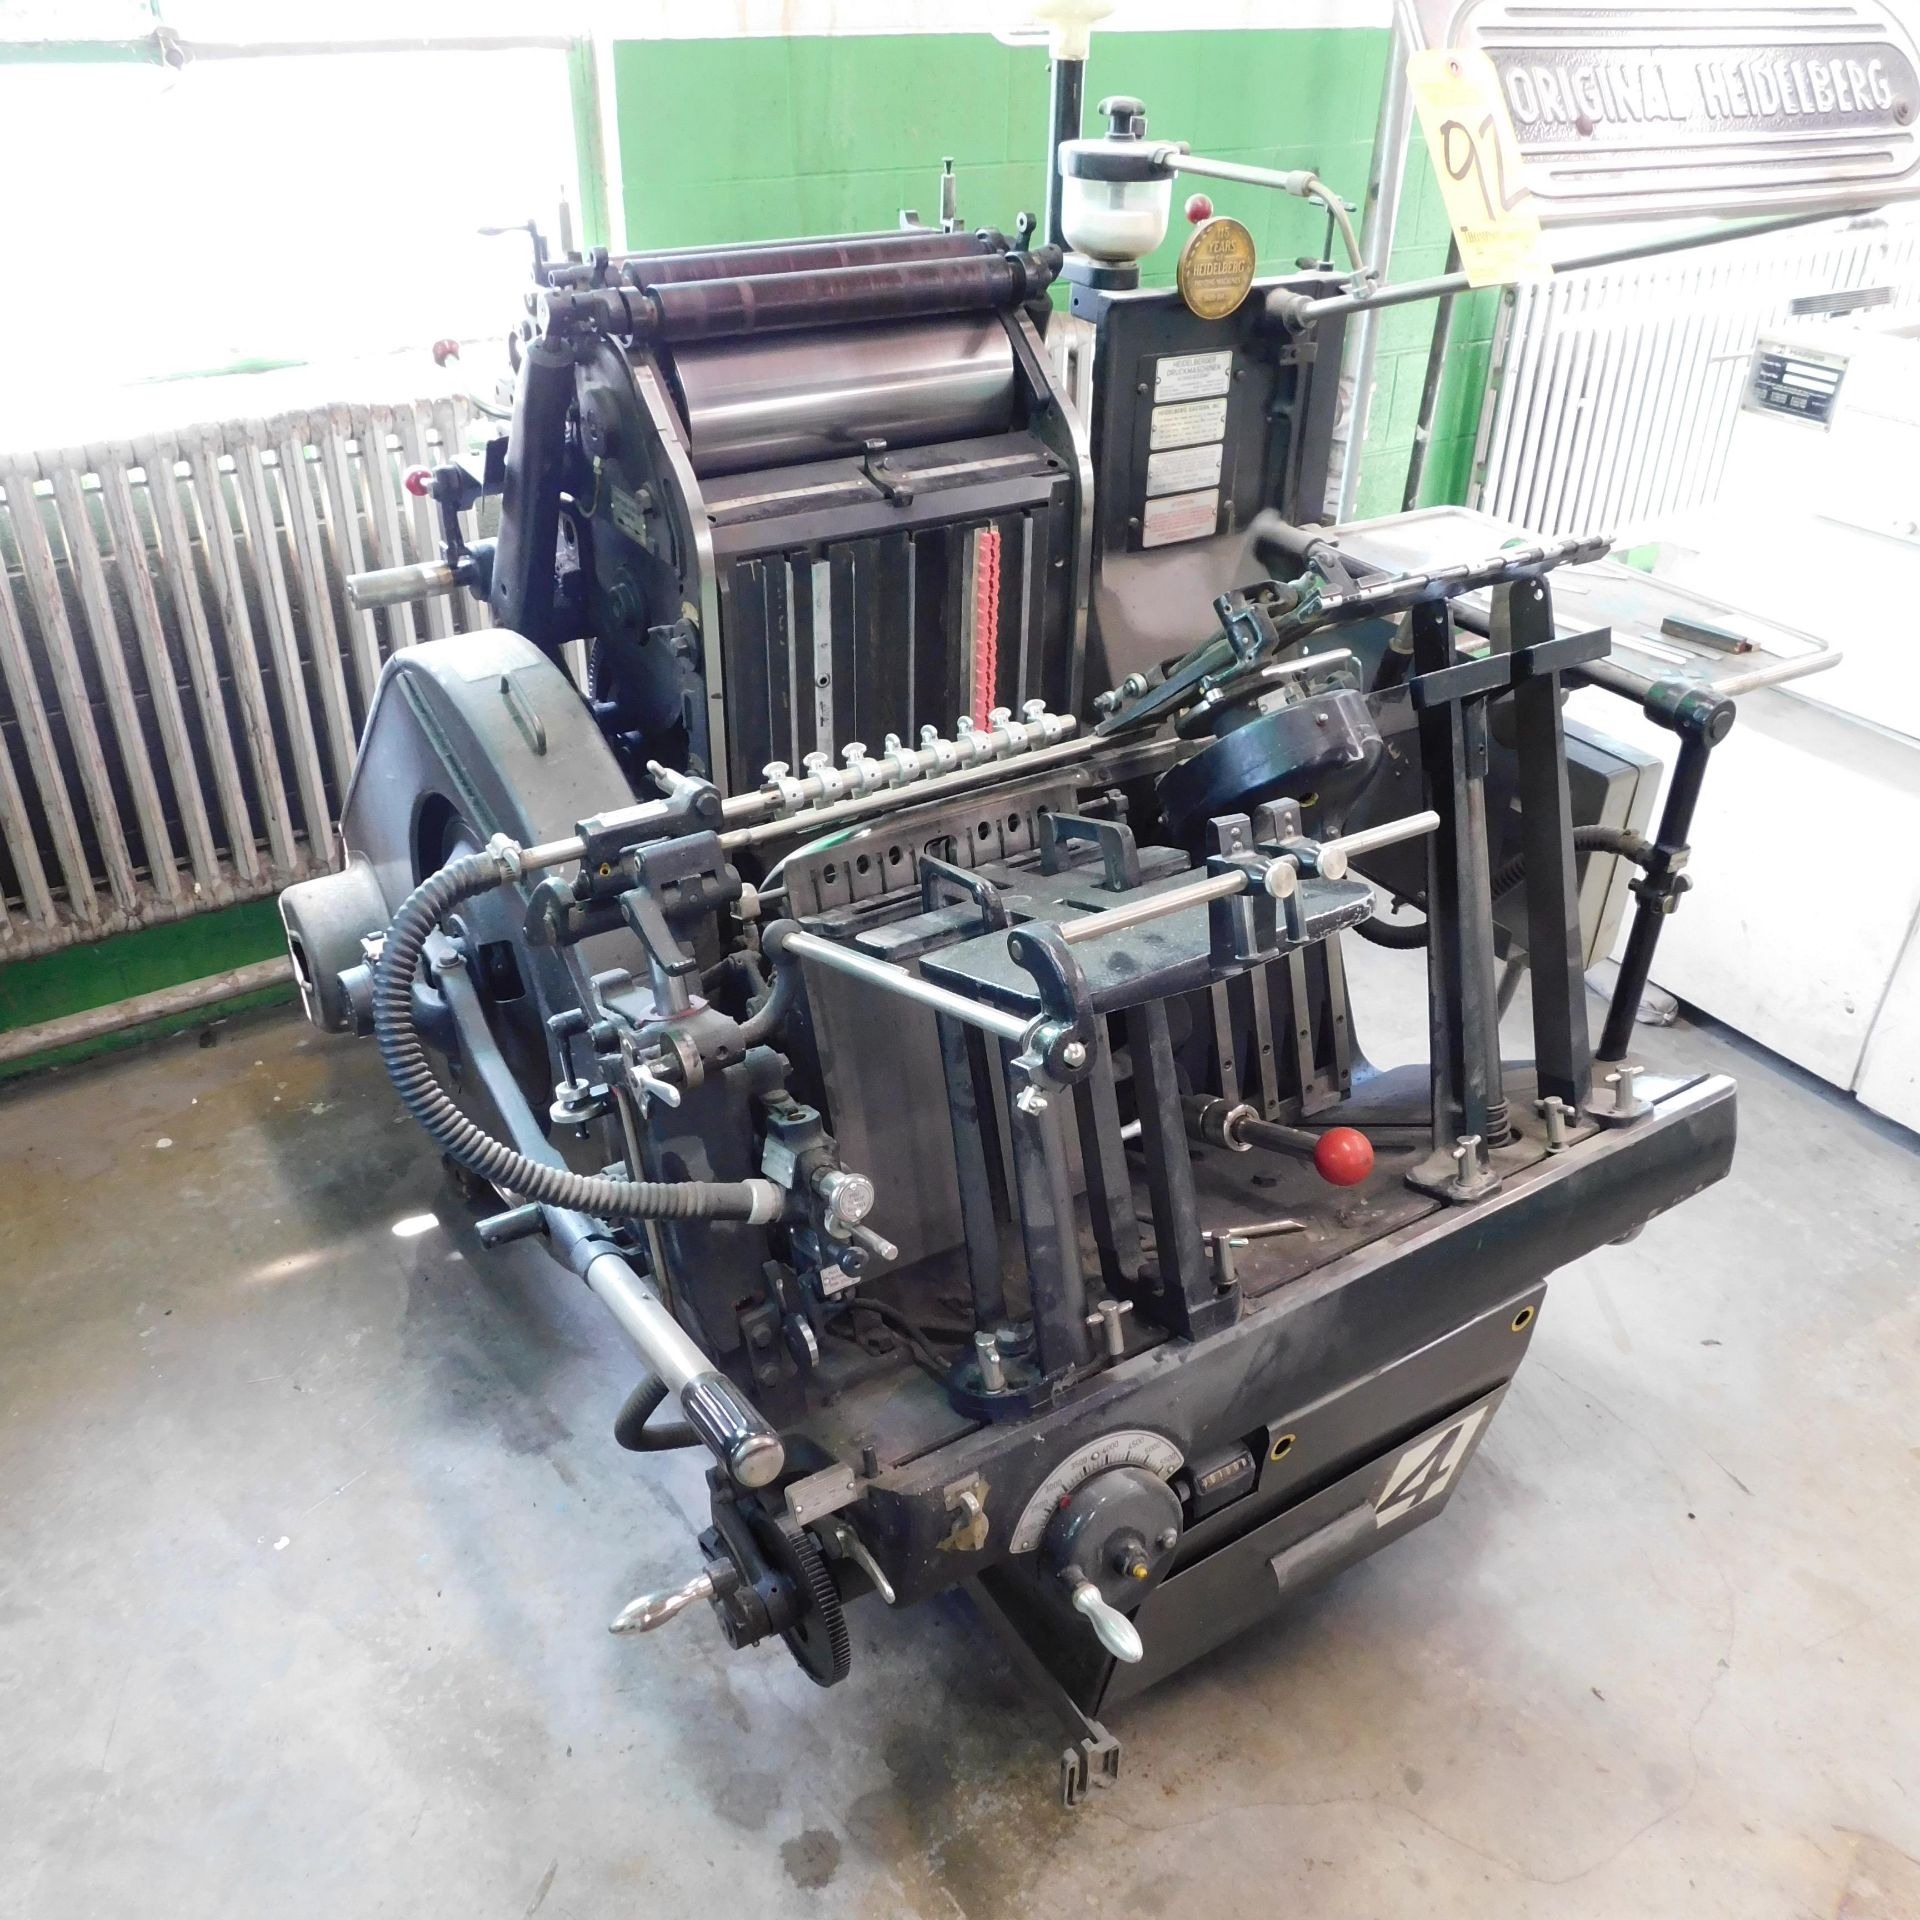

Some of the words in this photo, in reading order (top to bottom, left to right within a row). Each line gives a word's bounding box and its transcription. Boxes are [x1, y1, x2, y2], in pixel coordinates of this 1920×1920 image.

[1506, 62, 1687, 125] ORIGINAL
[1695, 58, 1893, 121] HEIDELBERG
[1217, 226, 1230, 238] 115
[1209, 239, 1237, 253] YEARS
[1193, 260, 1245, 276] HEIDELBERG
[1101, 1440, 1119, 1454] 4000
[1376, 1423, 1464, 1515] 4
